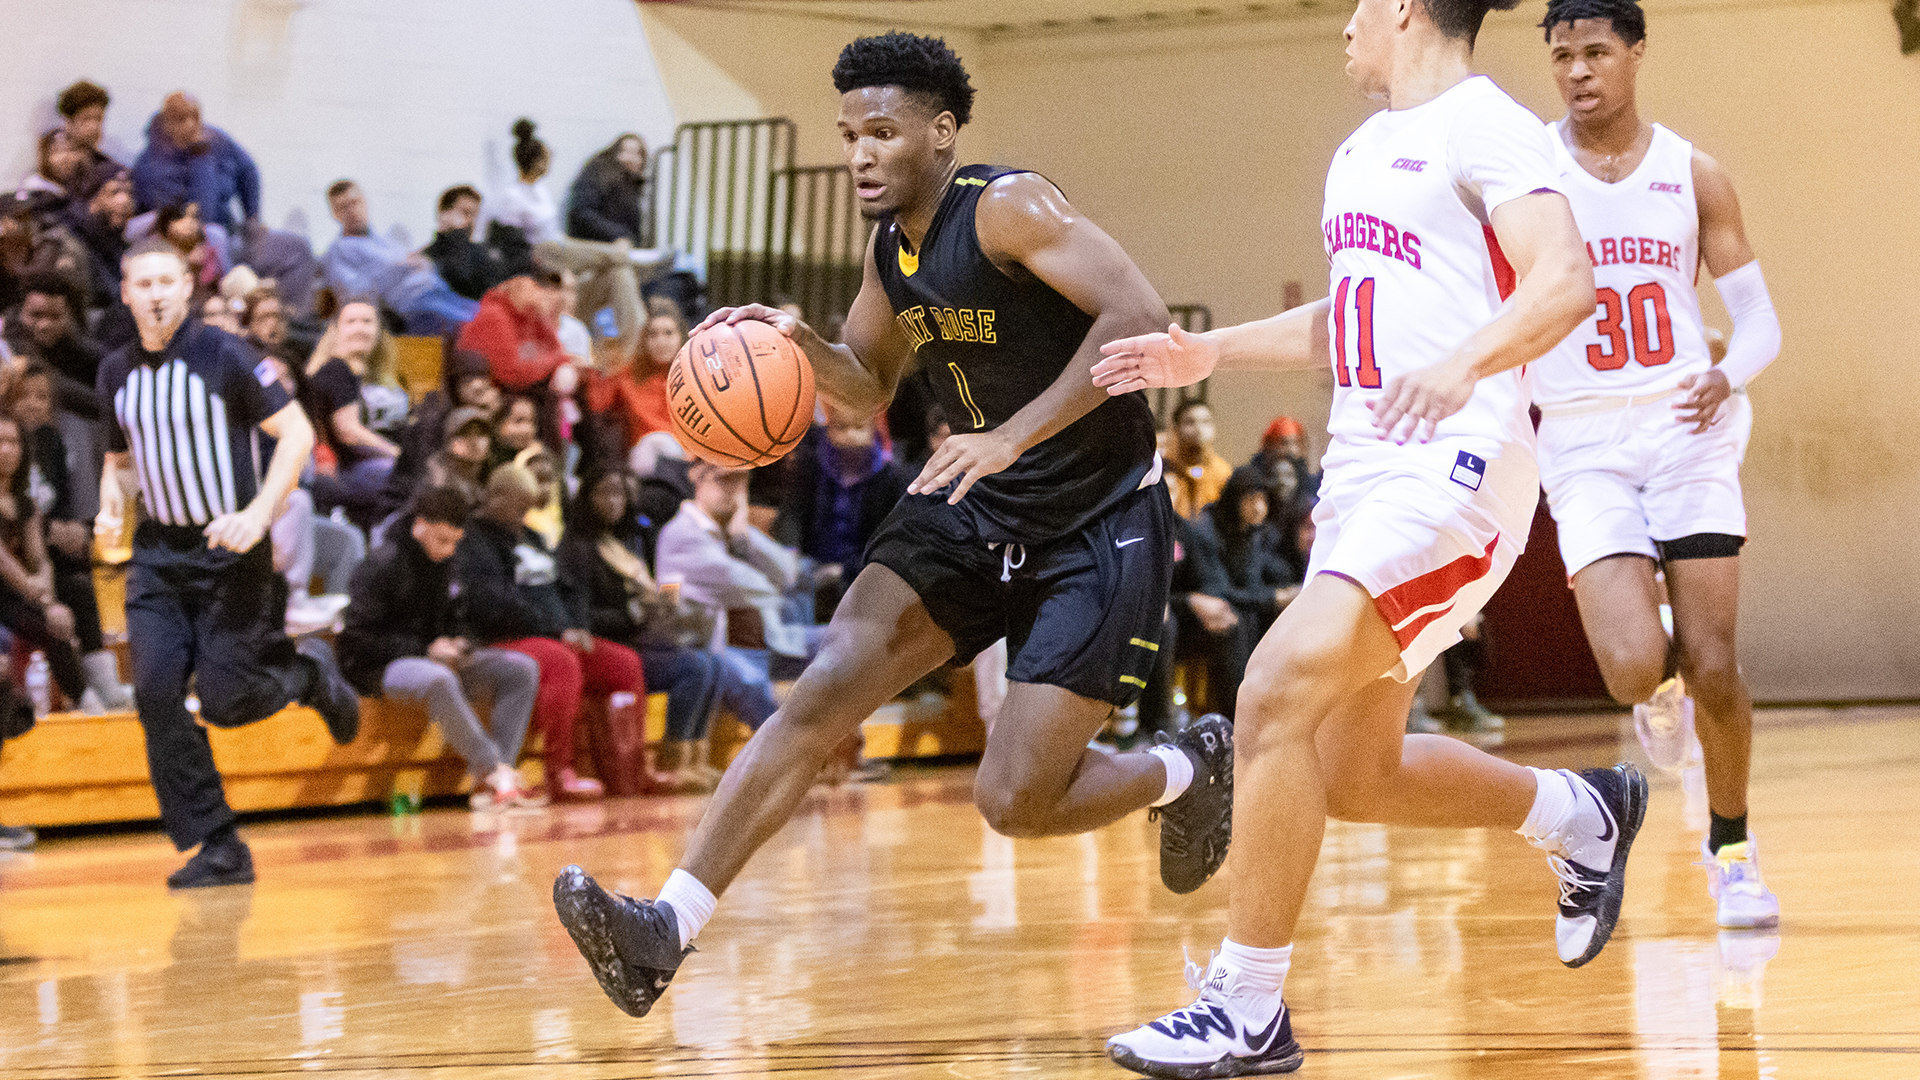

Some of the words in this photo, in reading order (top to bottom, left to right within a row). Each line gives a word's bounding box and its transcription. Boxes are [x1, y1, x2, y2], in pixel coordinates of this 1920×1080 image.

[929, 306, 996, 344] ROSE
[1334, 276, 1382, 389] 11
[1586, 281, 1675, 371] 30
[677, 395, 712, 437] THE
[948, 362, 984, 428] 1
[1467, 456, 1475, 468] L
